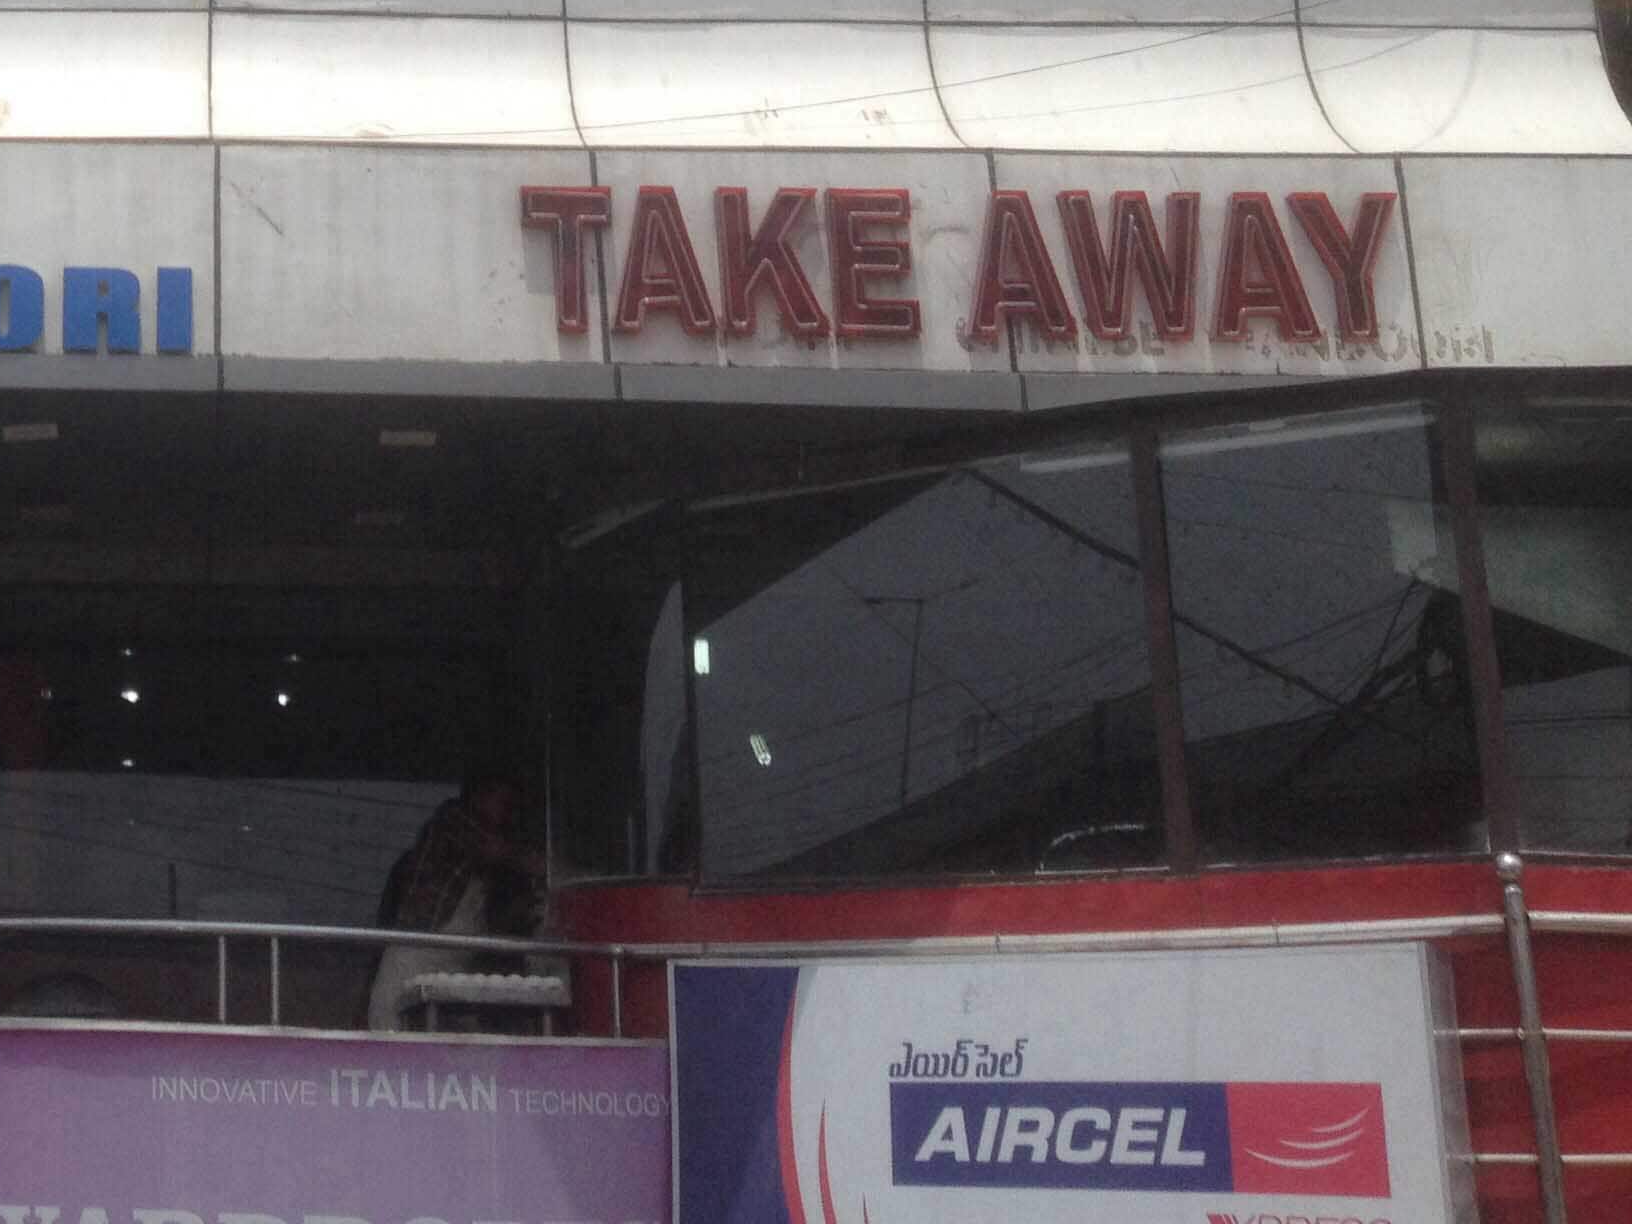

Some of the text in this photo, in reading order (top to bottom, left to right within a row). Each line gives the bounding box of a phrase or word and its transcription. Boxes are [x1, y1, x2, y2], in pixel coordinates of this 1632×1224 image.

[520, 184, 1397, 342] TAKE AWAY
[151, 1067, 670, 1118] INNOVATIVE ITALIAN TECHNOLOGY
[914, 1106, 1206, 1167] AIRCEL
